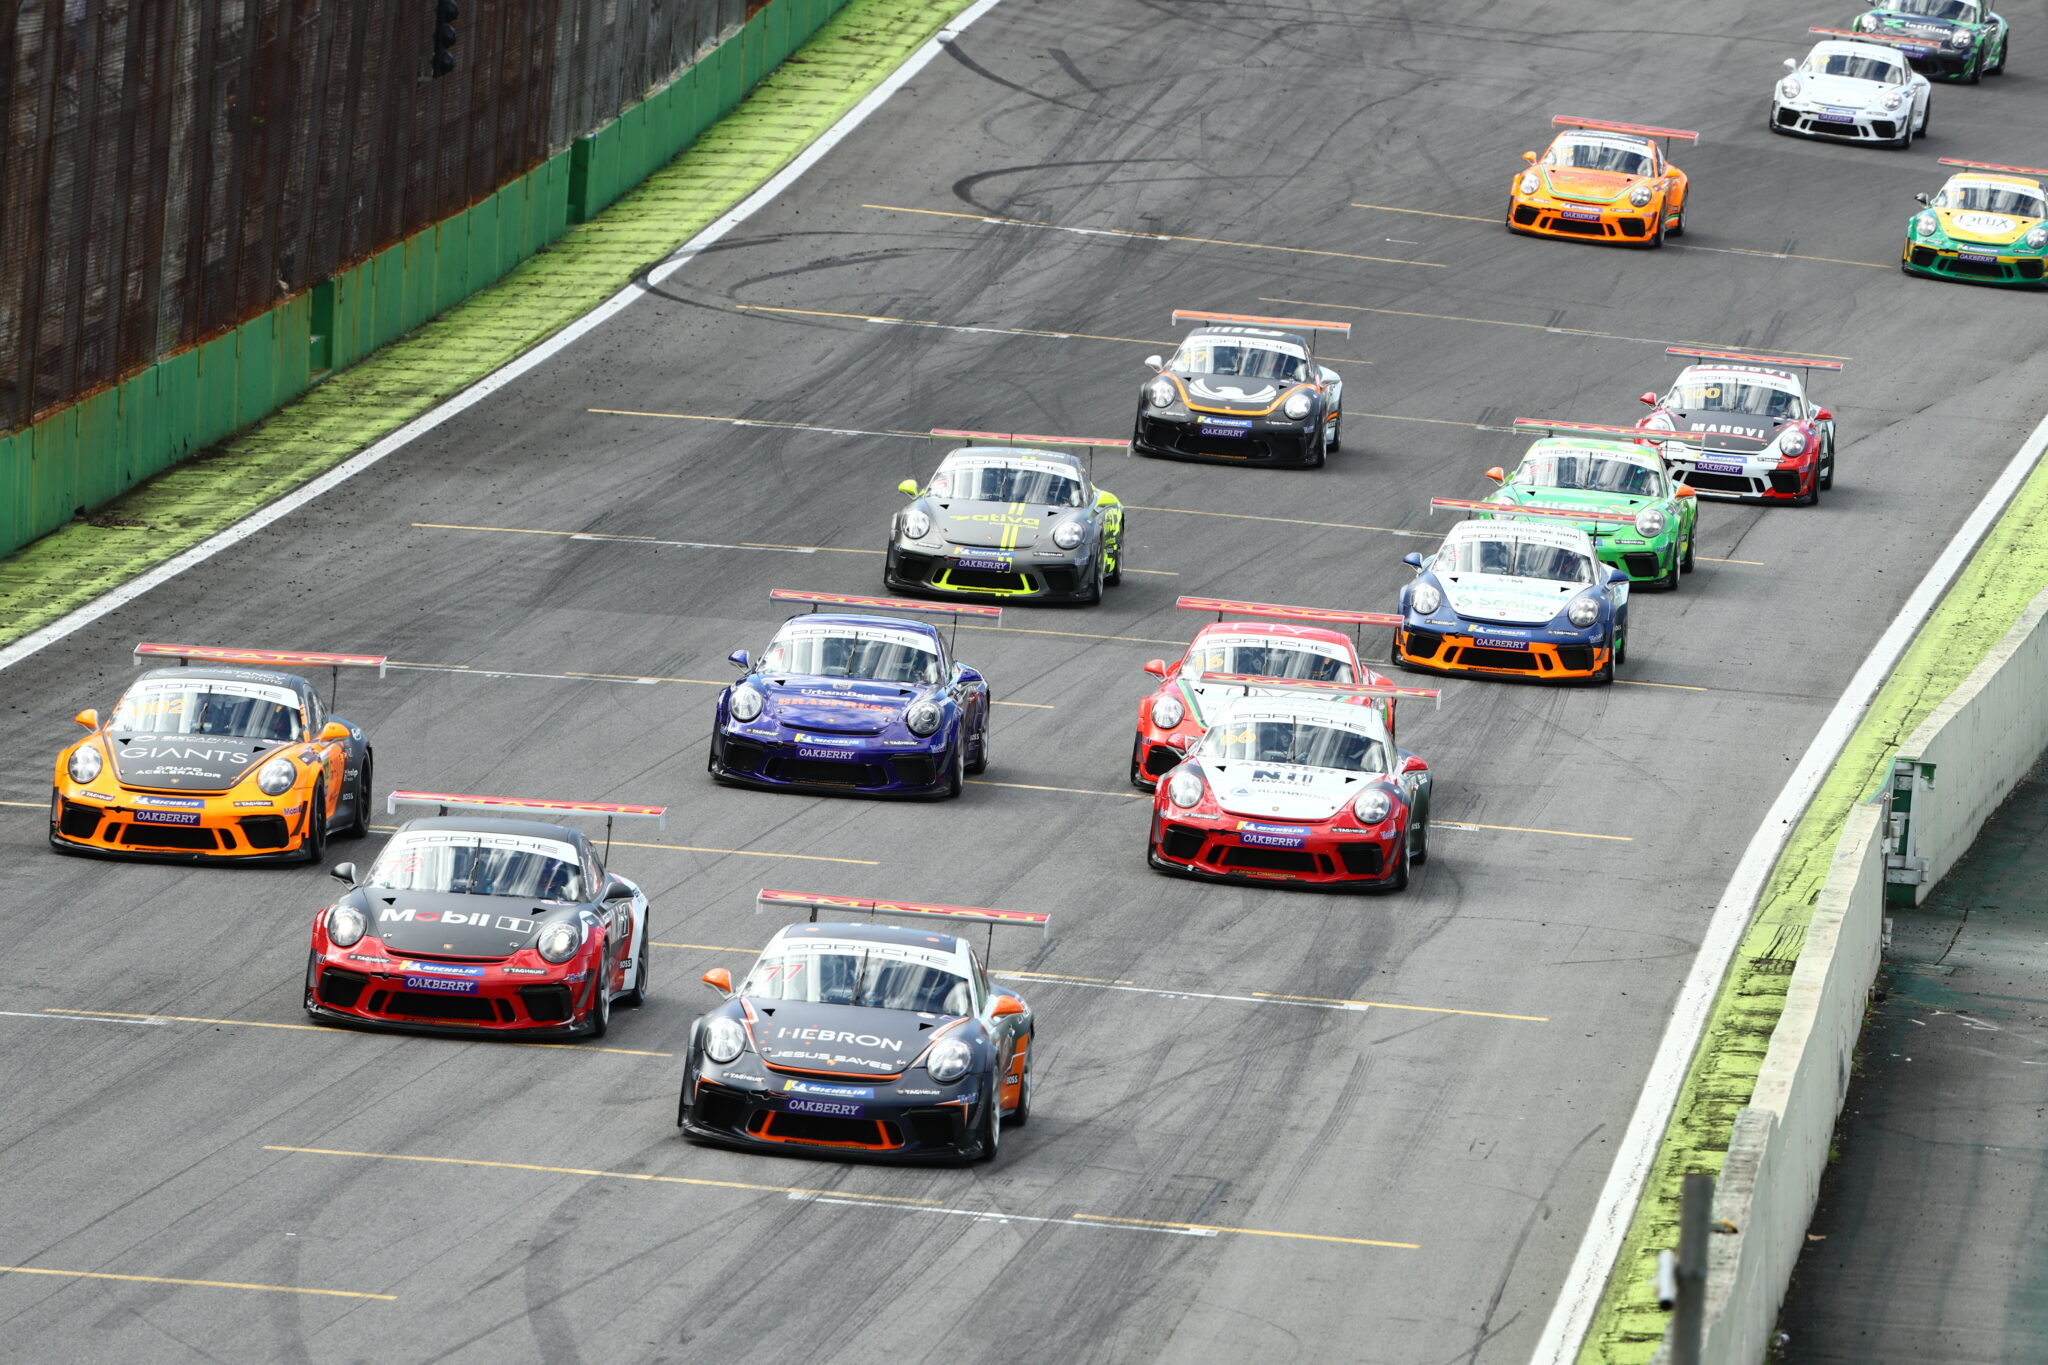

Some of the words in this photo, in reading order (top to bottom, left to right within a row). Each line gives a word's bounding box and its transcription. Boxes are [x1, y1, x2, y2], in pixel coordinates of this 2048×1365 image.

[1201, 428, 1245, 438] OAKBERRY
[1690, 423, 1765, 438] MAHOVI
[1697, 463, 1741, 473] OAKBERRY
[972, 513, 1040, 526] ativa
[1462, 533, 1575, 548] PORSCHE
[958, 560, 1007, 570] OAKBERRY
[1478, 595, 1547, 612] Senior
[792, 628, 920, 645] PORSCHE
[1476, 638, 1526, 649] OAKBERRY
[1207, 638, 1332, 654] PORSCHE
[145, 683, 282, 699] PORSCHE
[801, 688, 880, 700] UrbanoBank
[132, 698, 186, 718] 002
[1234, 713, 1366, 732] PORSCHE
[119, 747, 249, 764] GIANTS
[799, 748, 856, 760] OAKBERRY
[135, 769, 222, 779] ACELERADOR
[156, 765, 204, 773] GRUPO
[149, 798, 200, 808] MICHELIN
[136, 811, 198, 824] OAKBERRY
[1256, 825, 1306, 834] MICHELIN
[406, 835, 559, 854] PORSCHE
[1243, 834, 1302, 847] OAKBERRY
[378, 908, 489, 927] Mobil
[788, 943, 948, 967] PORSCHE
[422, 965, 478, 975] MICHELIN
[763, 962, 805, 984] 77
[406, 977, 475, 992] OAKBERRY
[777, 1026, 904, 1052] HEBRON
[770, 1050, 831, 1061] JESUS
[833, 1054, 893, 1071] SAVES
[808, 1085, 867, 1096] MICHELIN
[788, 1099, 860, 1116] OAKBERRY
